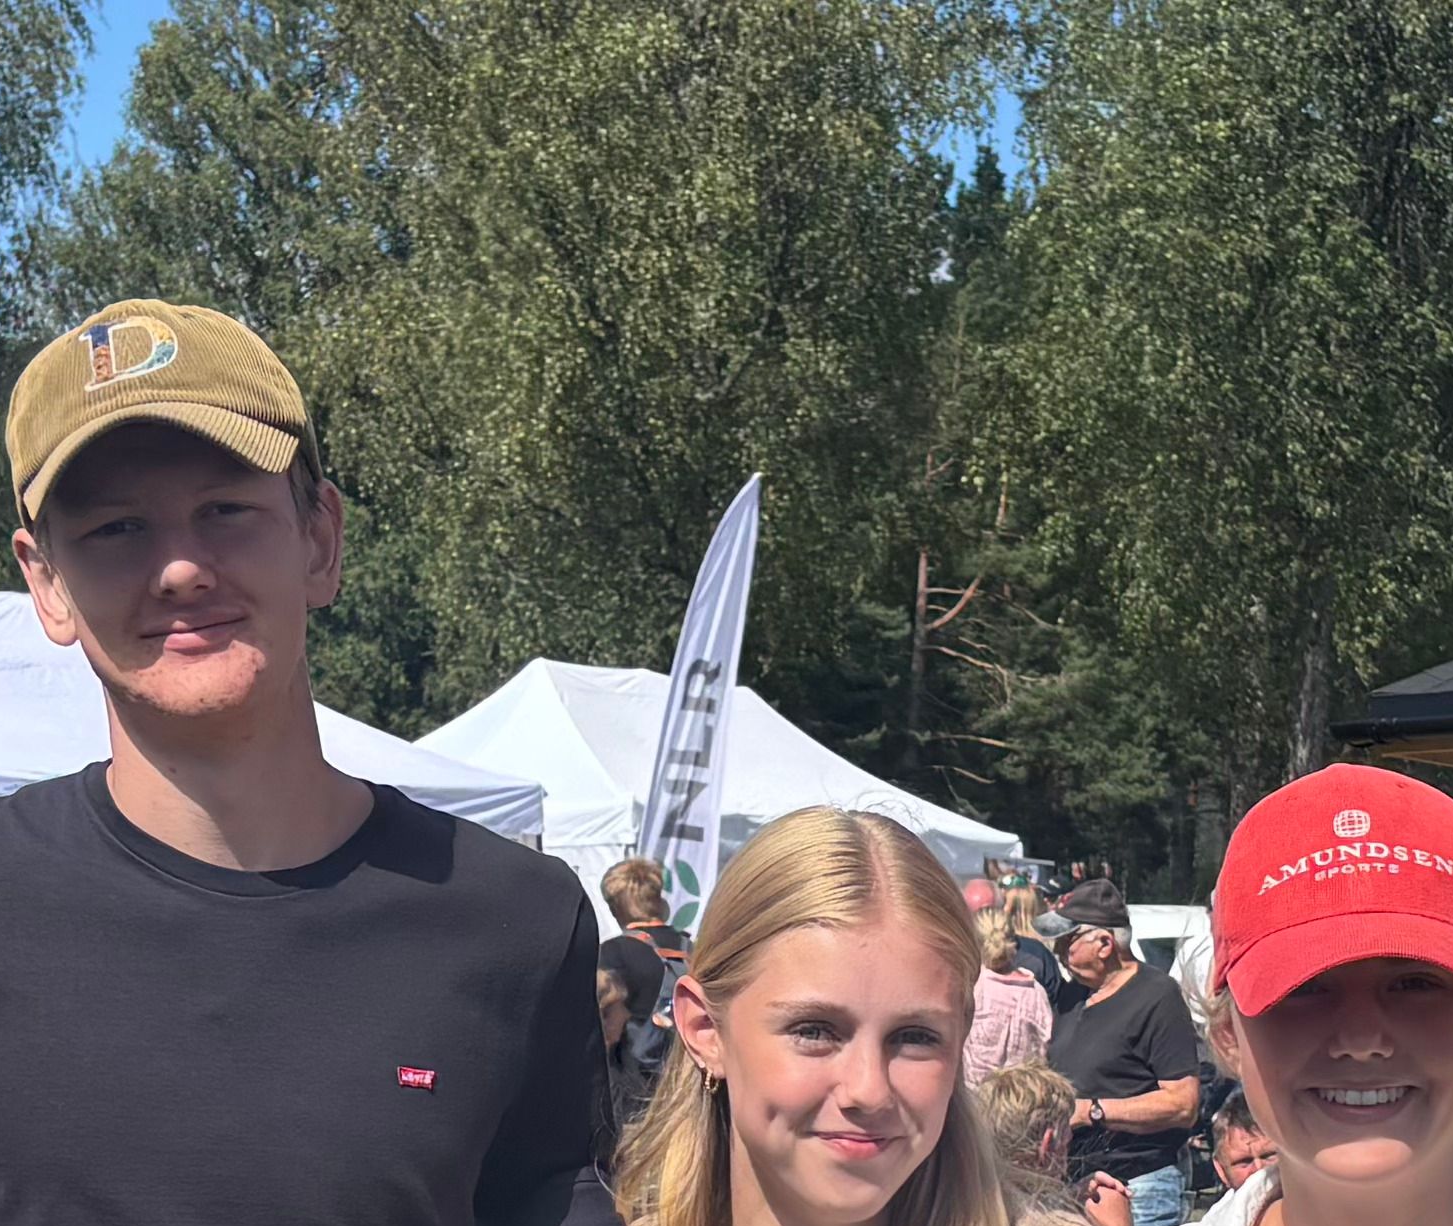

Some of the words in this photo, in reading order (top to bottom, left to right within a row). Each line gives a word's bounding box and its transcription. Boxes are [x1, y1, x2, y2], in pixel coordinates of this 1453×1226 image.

[78, 315, 179, 393] D
[660, 658, 723, 842] NLR
[1313, 862, 1400, 882] SPORTS
